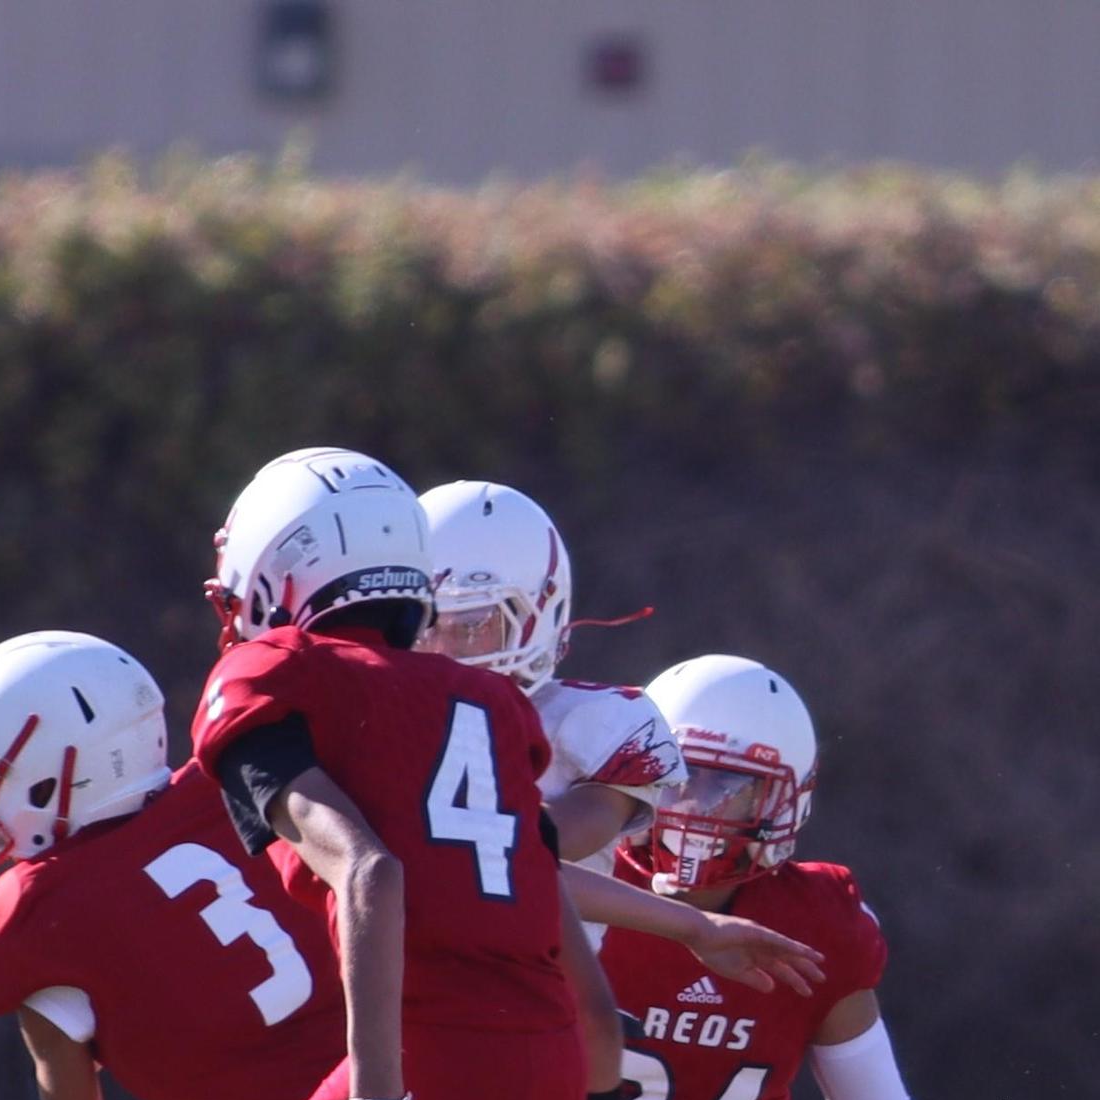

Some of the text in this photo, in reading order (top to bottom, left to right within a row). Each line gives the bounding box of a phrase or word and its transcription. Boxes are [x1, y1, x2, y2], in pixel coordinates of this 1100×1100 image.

[358, 567, 419, 590] schutt
[423, 696, 518, 900] 4
[143, 842, 313, 1026] 3
[676, 991, 723, 1005] adidas
[643, 1006, 756, 1050] REDS
